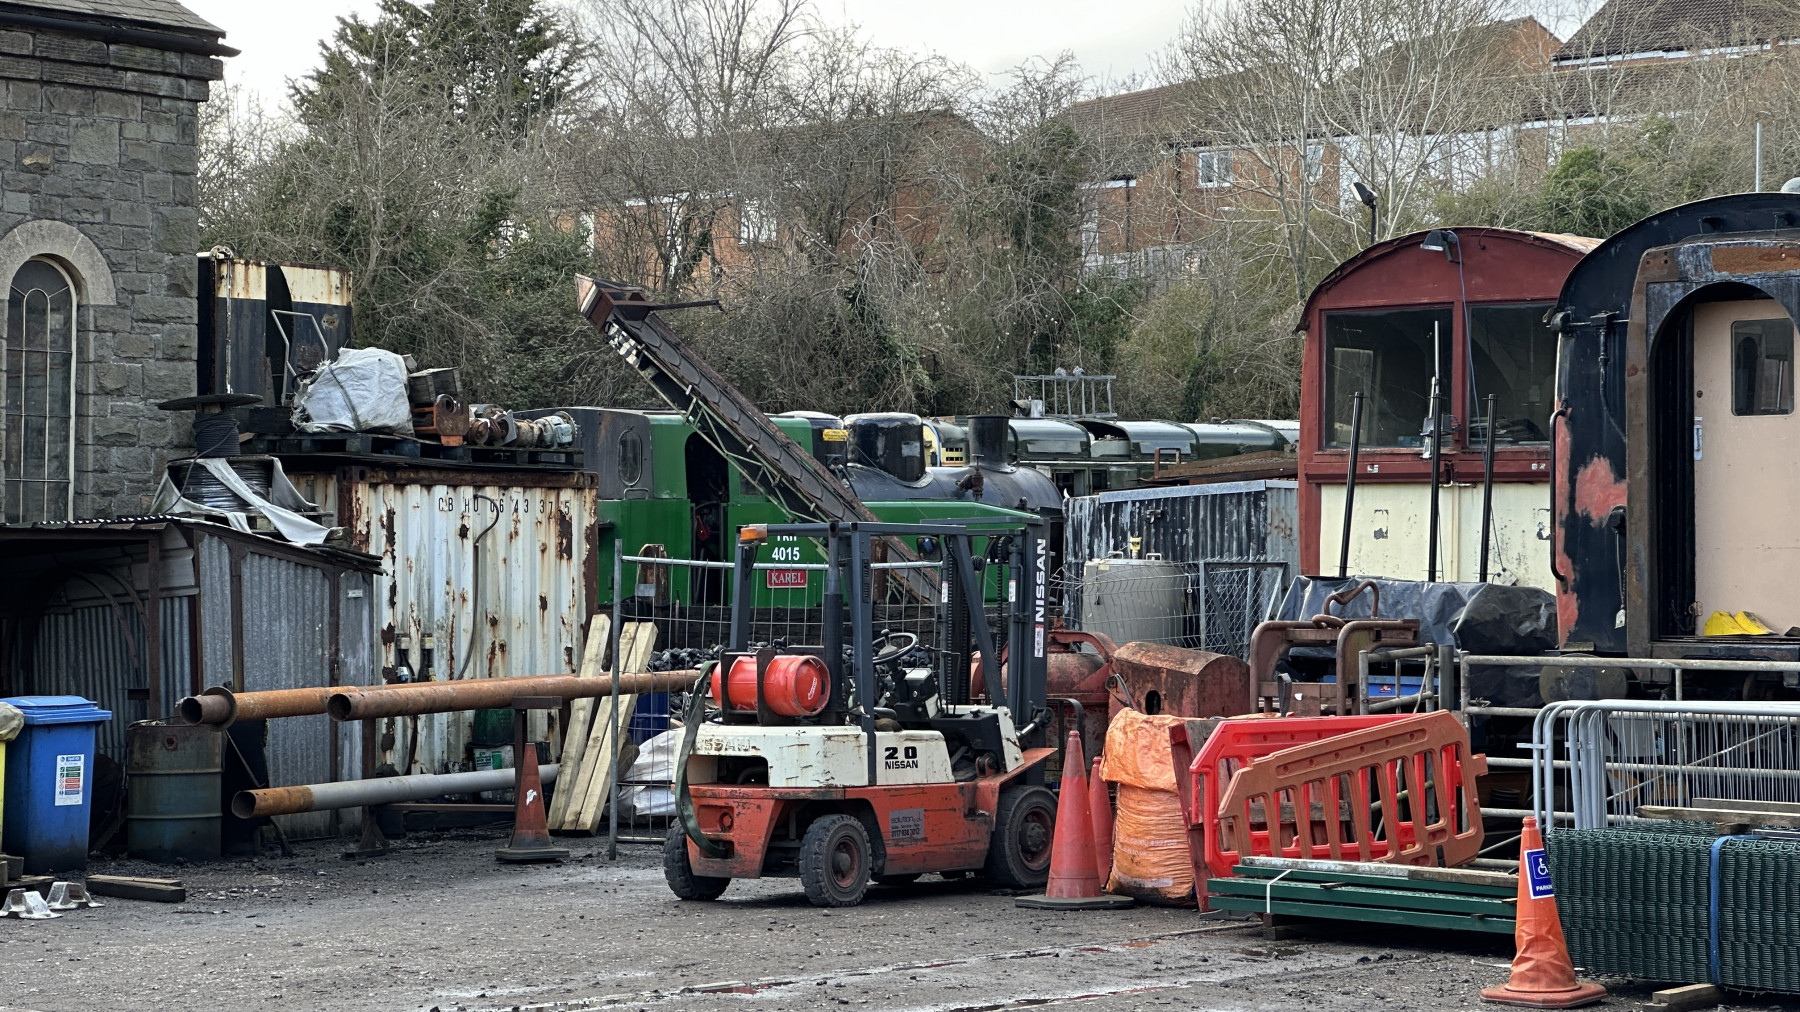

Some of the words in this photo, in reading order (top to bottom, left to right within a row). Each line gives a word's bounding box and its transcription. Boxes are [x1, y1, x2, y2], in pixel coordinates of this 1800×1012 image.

[771, 546, 800, 561] 4015
[771, 572, 804, 584] KAREL
[1035, 538, 1046, 622] NISSAN
[884, 760, 919, 770] NISSAN
